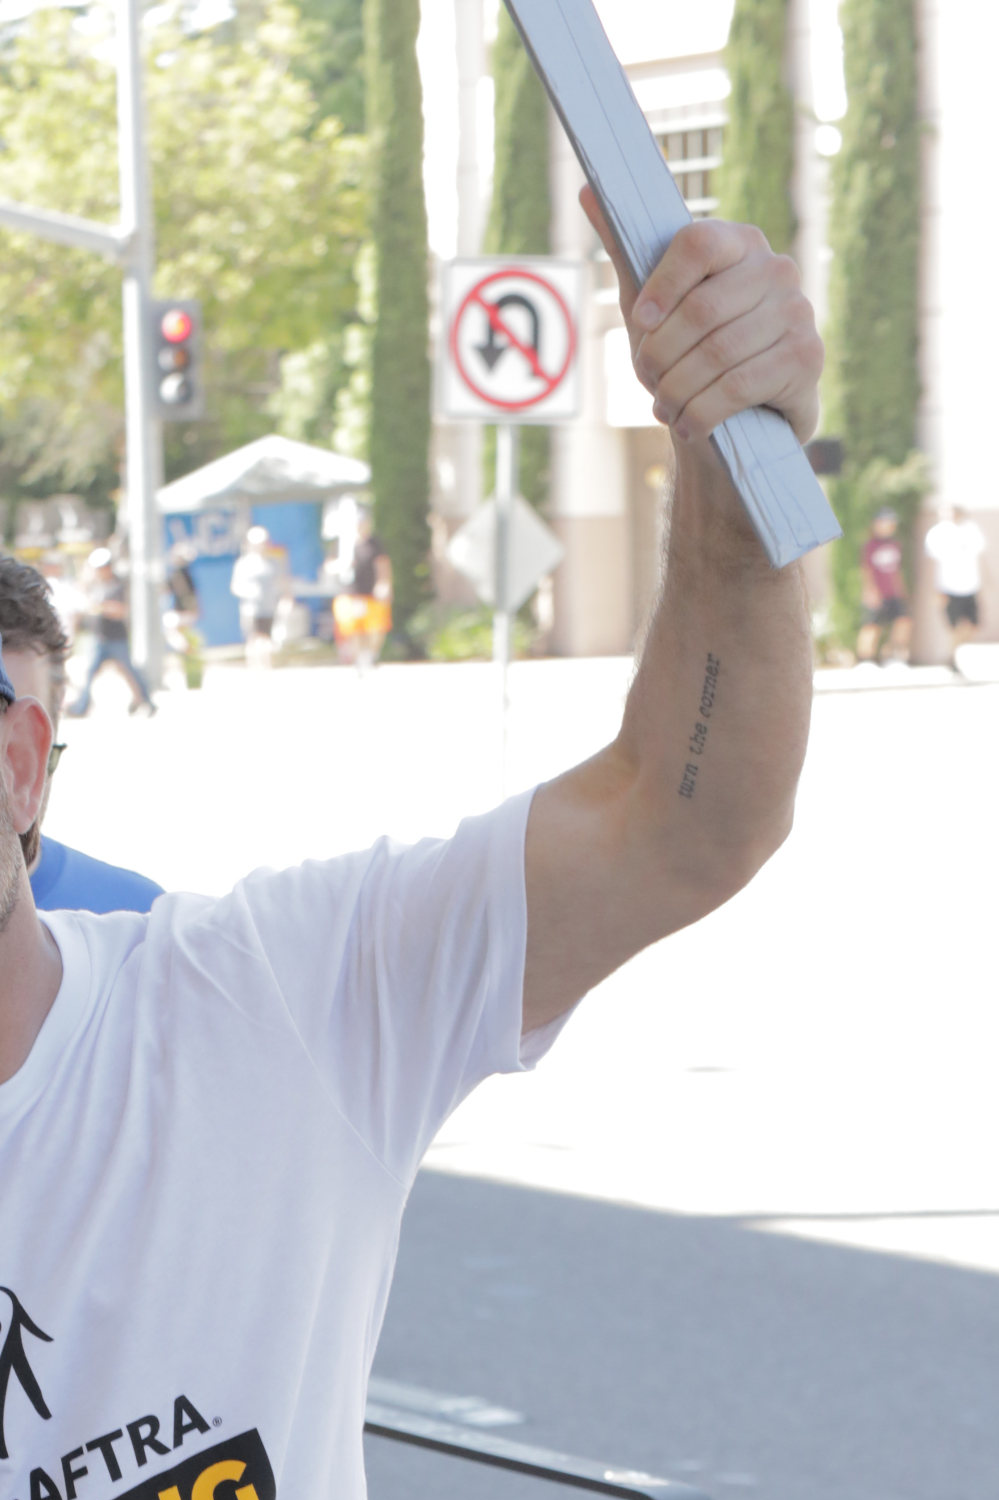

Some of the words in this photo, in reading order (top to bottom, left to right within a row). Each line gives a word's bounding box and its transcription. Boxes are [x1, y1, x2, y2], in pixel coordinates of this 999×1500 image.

[678, 762, 698, 799] turn
[688, 721, 708, 756] the
[698, 652, 720, 719] corner
